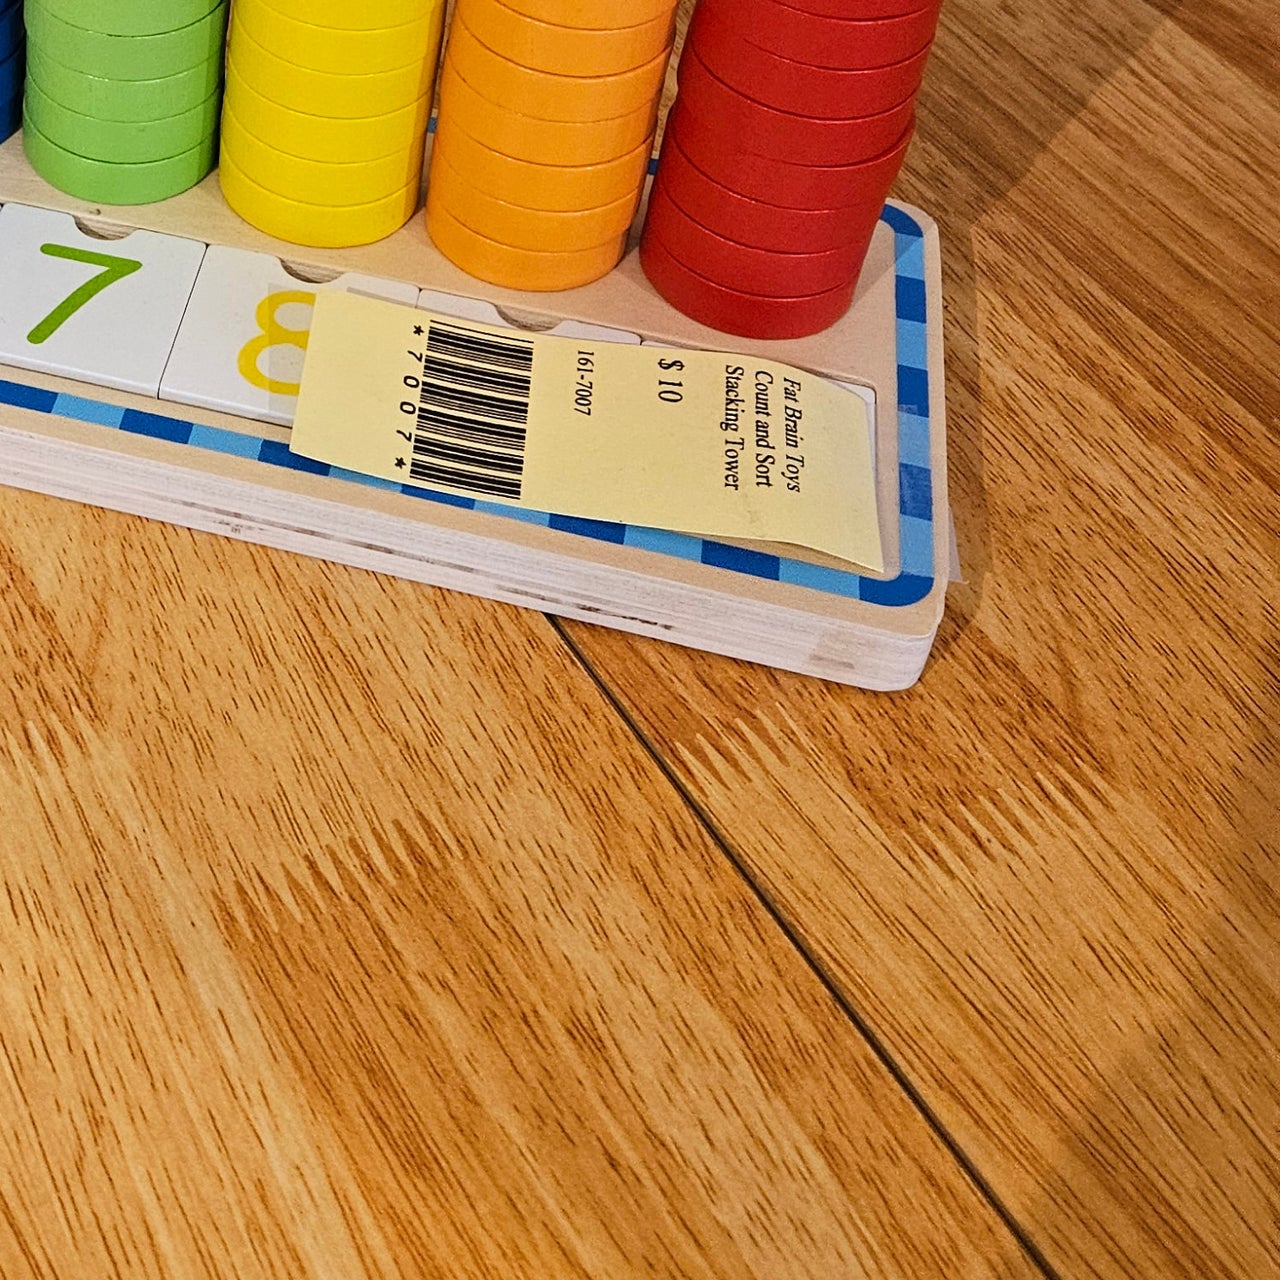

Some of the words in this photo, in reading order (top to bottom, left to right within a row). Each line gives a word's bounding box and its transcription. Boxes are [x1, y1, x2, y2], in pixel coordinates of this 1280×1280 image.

[26, 243, 143, 345] 7
[573, 350, 595, 417] 161-7007
[720, 364, 746, 432] Stacking
[754, 370, 774, 418] Count
[783, 376, 802, 403] Fat
[755, 419, 776, 450] and
[784, 405, 804, 449] Brain
[724, 437, 745, 491] Tower
[755, 453, 776, 488] Sort
[781, 454, 805, 493] Toys
